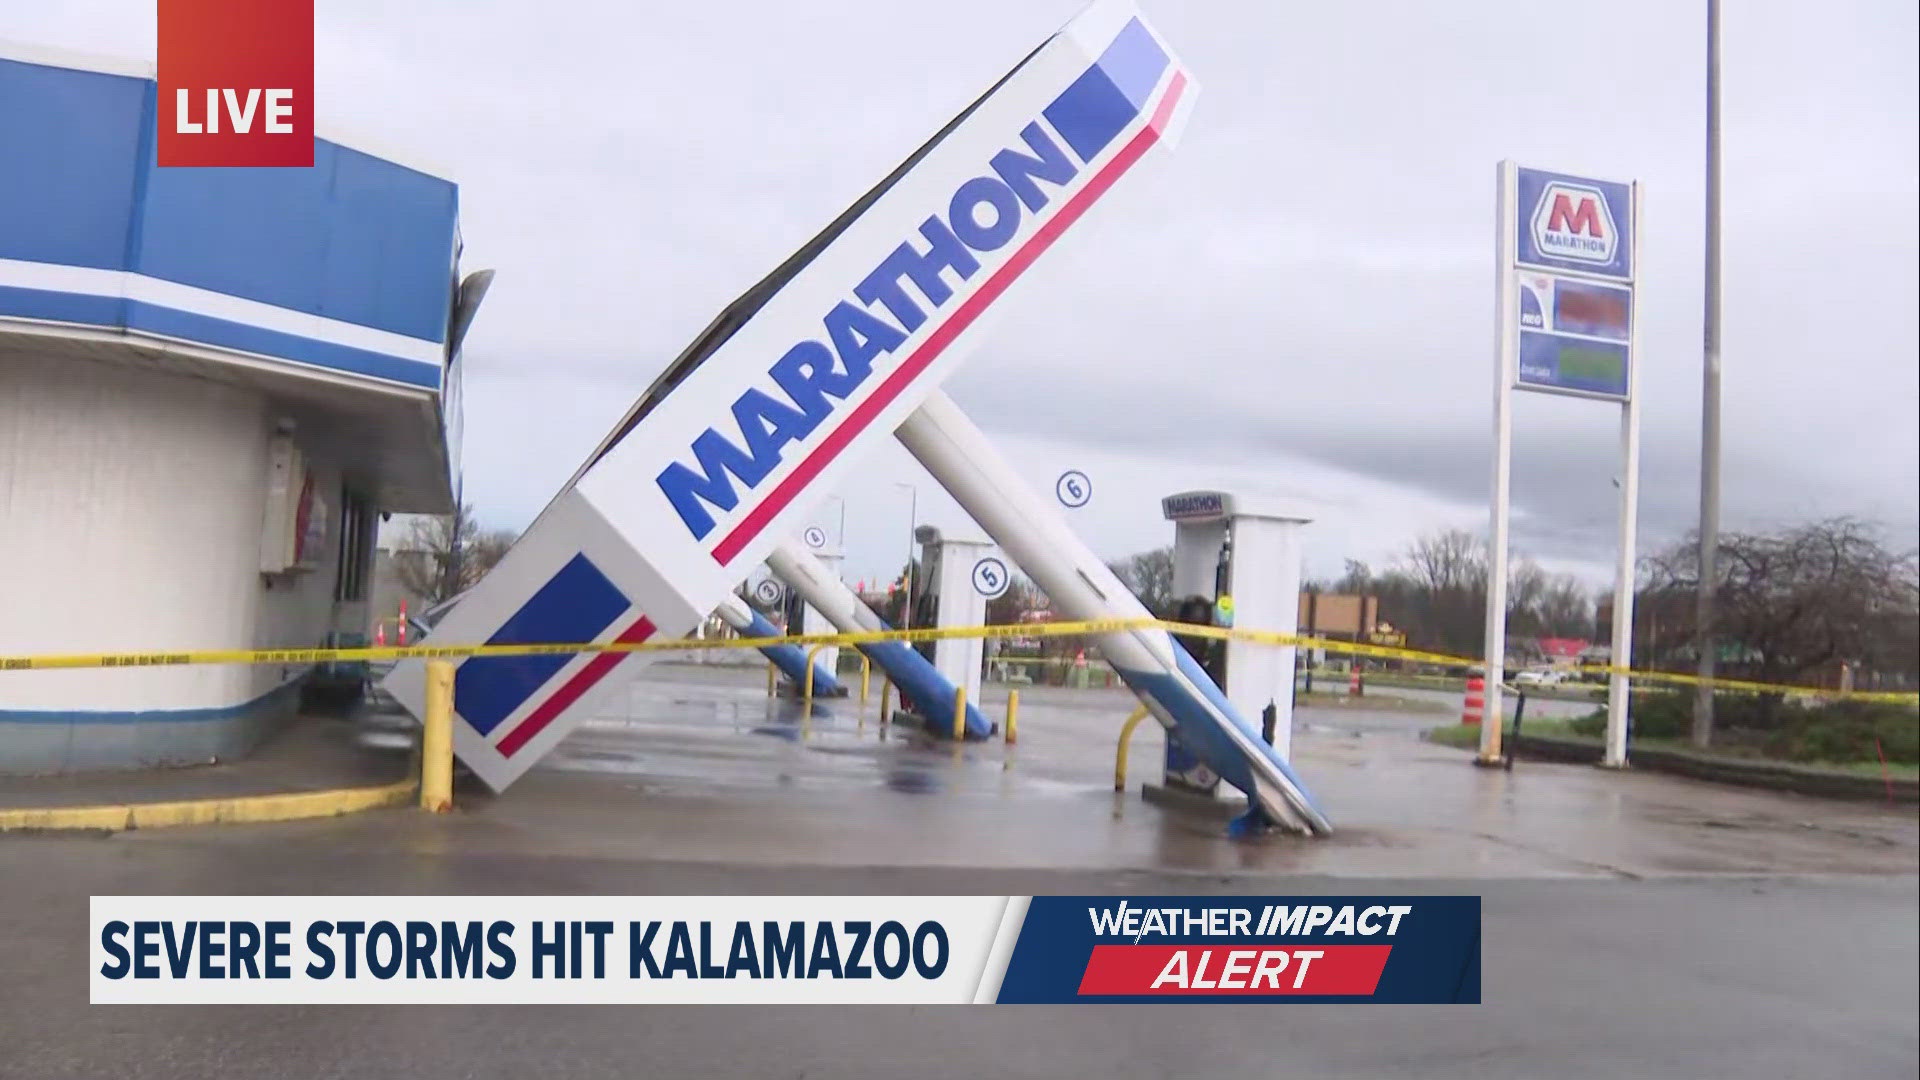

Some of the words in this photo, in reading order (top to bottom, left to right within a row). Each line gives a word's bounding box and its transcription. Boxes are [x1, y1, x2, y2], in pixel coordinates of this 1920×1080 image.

[1547, 194, 1603, 238] M
[1544, 233, 1606, 253] MARATHON
[656, 119, 1079, 542] MARATHON
[1168, 494, 1223, 514] MARATHON
[982, 566, 998, 588] 5
